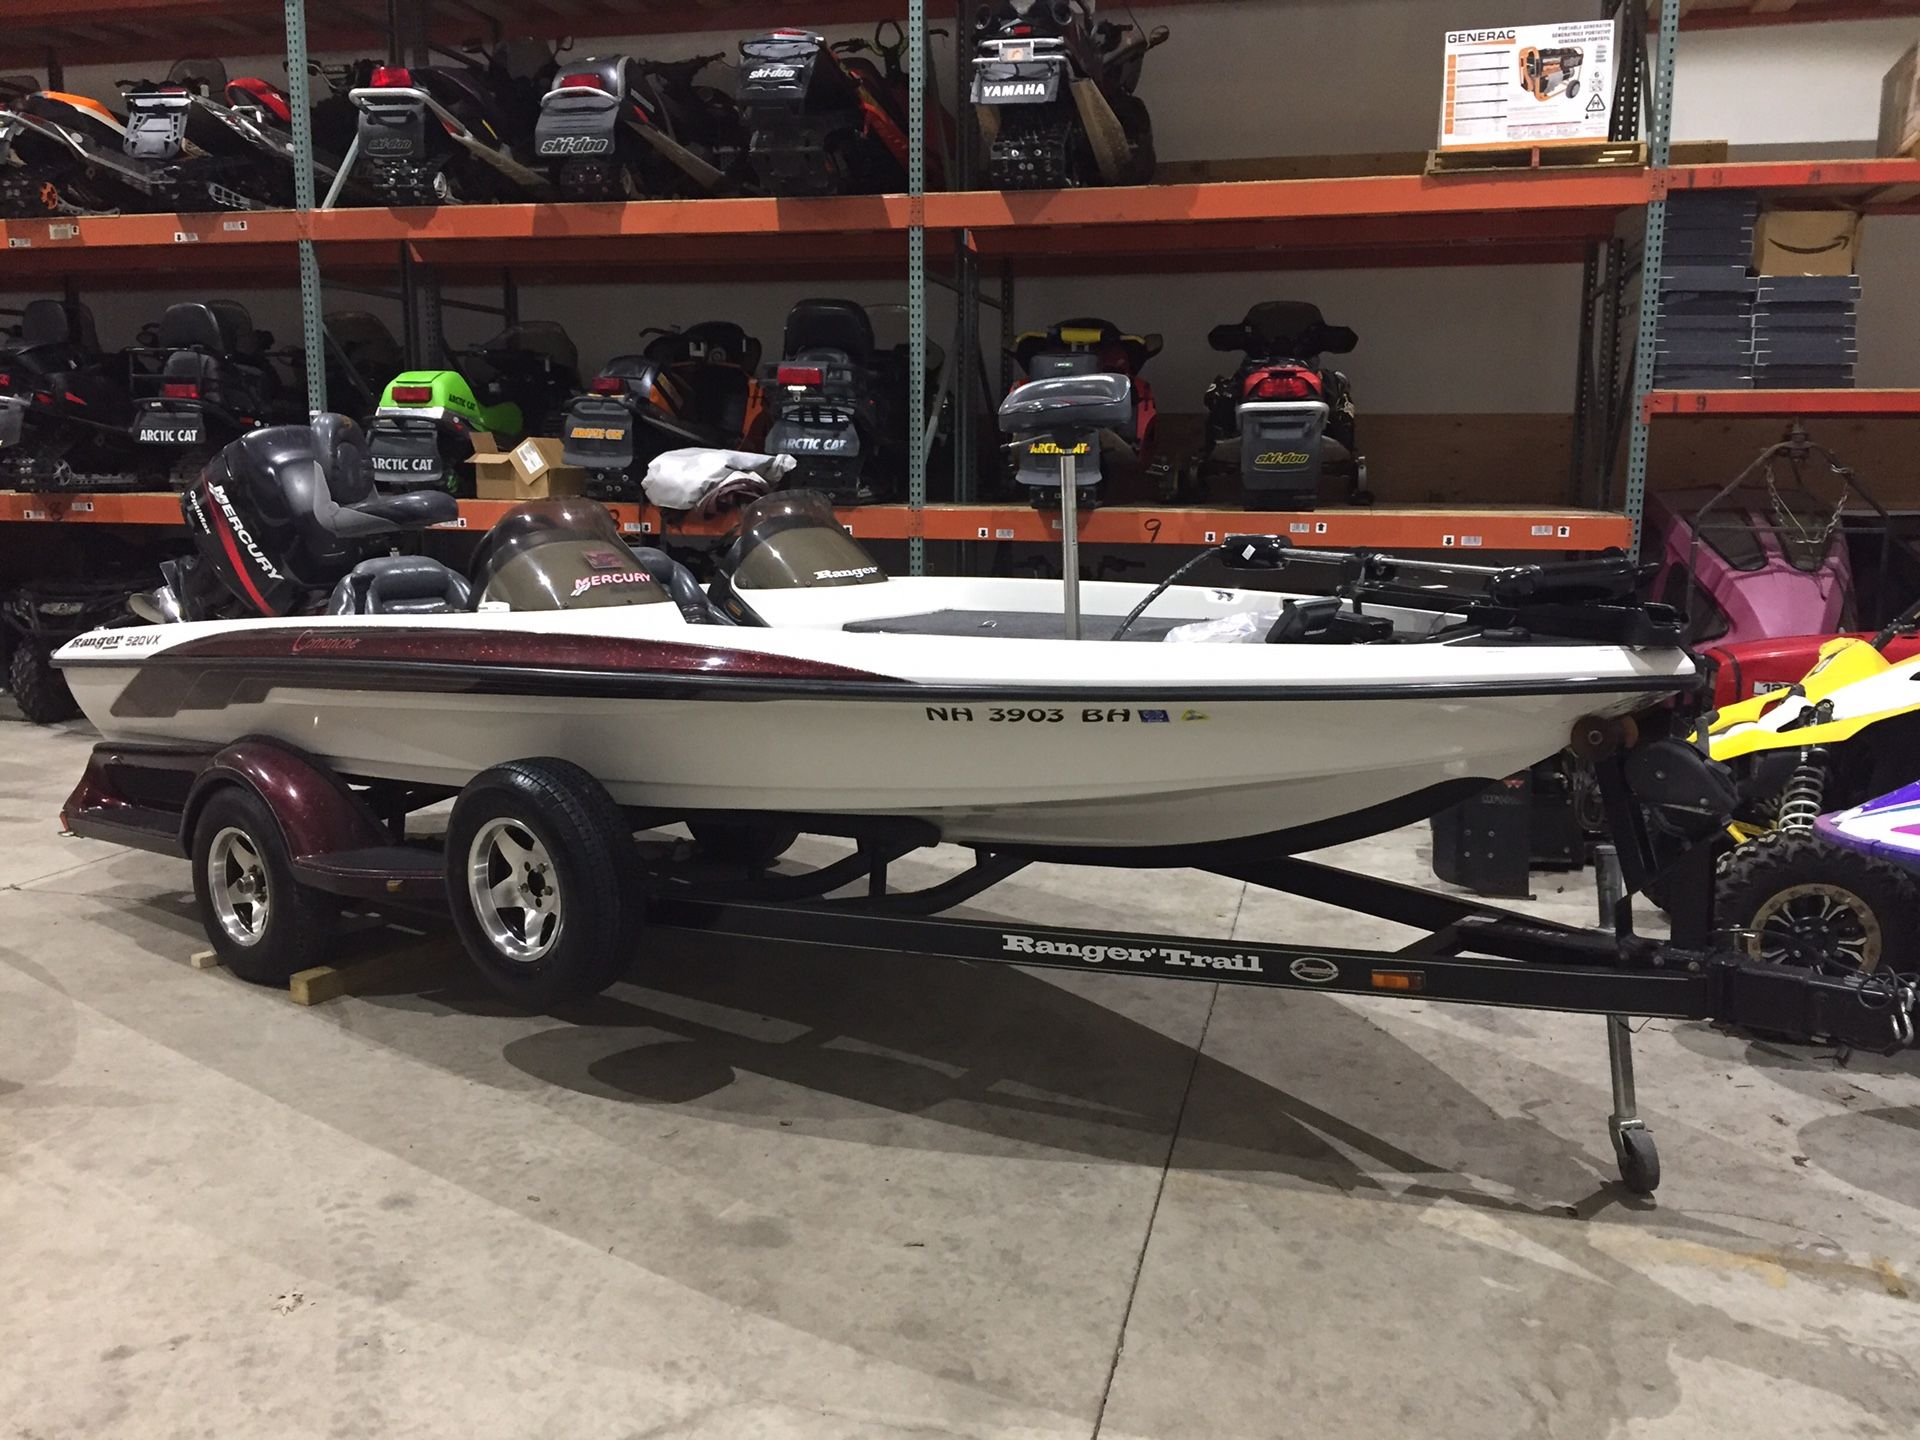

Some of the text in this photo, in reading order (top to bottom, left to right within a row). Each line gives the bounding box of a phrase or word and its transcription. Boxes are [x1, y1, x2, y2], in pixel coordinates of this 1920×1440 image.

[1447, 30, 1516, 44] GENERAC
[748, 67, 795, 80] ski-doo
[983, 83, 1046, 97] YAMAHA
[540, 136, 609, 154] ski-doo
[140, 429, 198, 442] ARCTIC CAT
[780, 438, 847, 451] ARCTIC CAT
[411, 458, 433, 471] CAT
[1254, 452, 1310, 465] ski-doo
[207, 481, 284, 580] MERCURY
[1144, 518, 1162, 543] 9
[813, 566, 878, 580] Ranger
[570, 572, 651, 597] MERCURY
[69, 634, 161, 650] Ranger 520VX
[926, 707, 973, 721] NH
[988, 708, 1064, 722] 3903
[1082, 708, 1131, 722] BH
[1159, 948, 1264, 972] Trail
